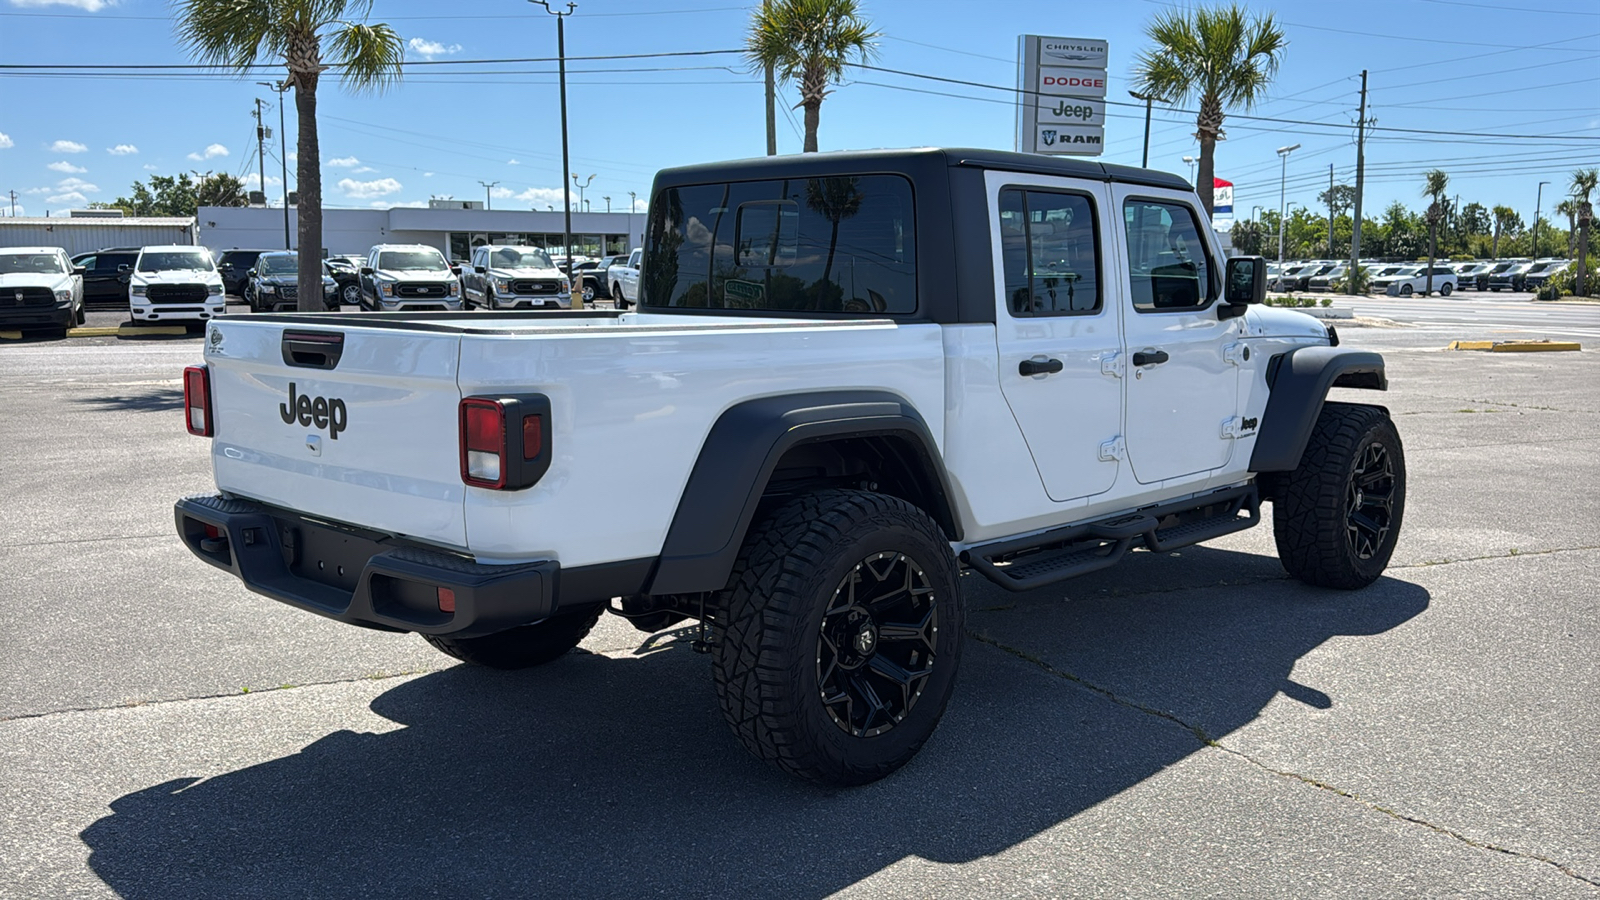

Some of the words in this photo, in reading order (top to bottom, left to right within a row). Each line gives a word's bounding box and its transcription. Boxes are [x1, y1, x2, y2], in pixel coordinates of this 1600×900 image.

[1046, 44, 1104, 53] CHRYSLER
[1043, 76, 1104, 88] DODGE
[1052, 100, 1093, 121] Jeep
[1059, 134, 1101, 144] RAM
[279, 382, 347, 440] Jeep
